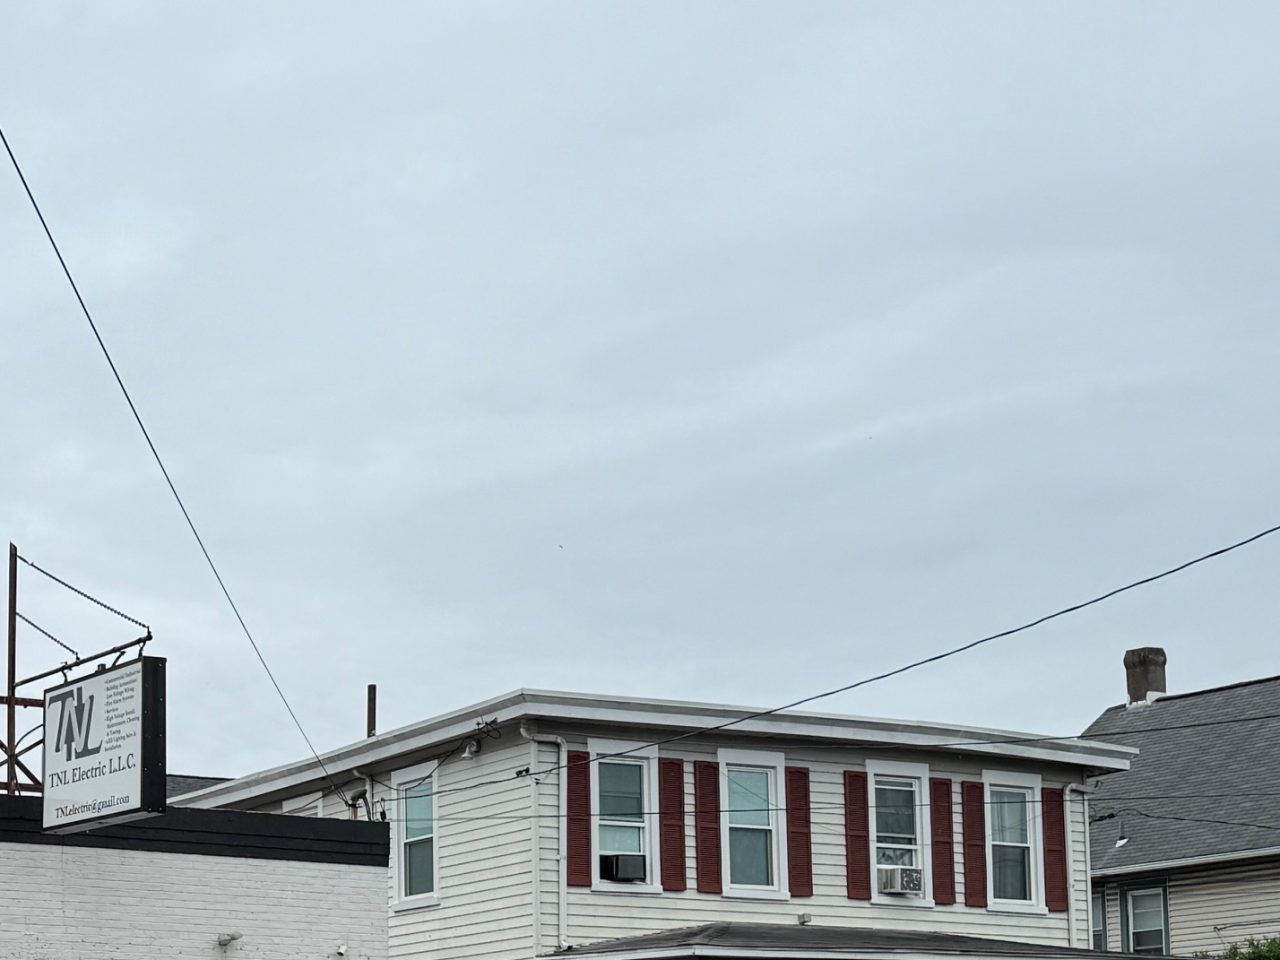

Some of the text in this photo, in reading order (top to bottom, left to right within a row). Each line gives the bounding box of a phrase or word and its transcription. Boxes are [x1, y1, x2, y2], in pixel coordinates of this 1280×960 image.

[48, 769, 70, 789] TNL
[71, 761, 107, 783] Electric
[55, 795, 130, 819] TNLelectric@gmail.com
